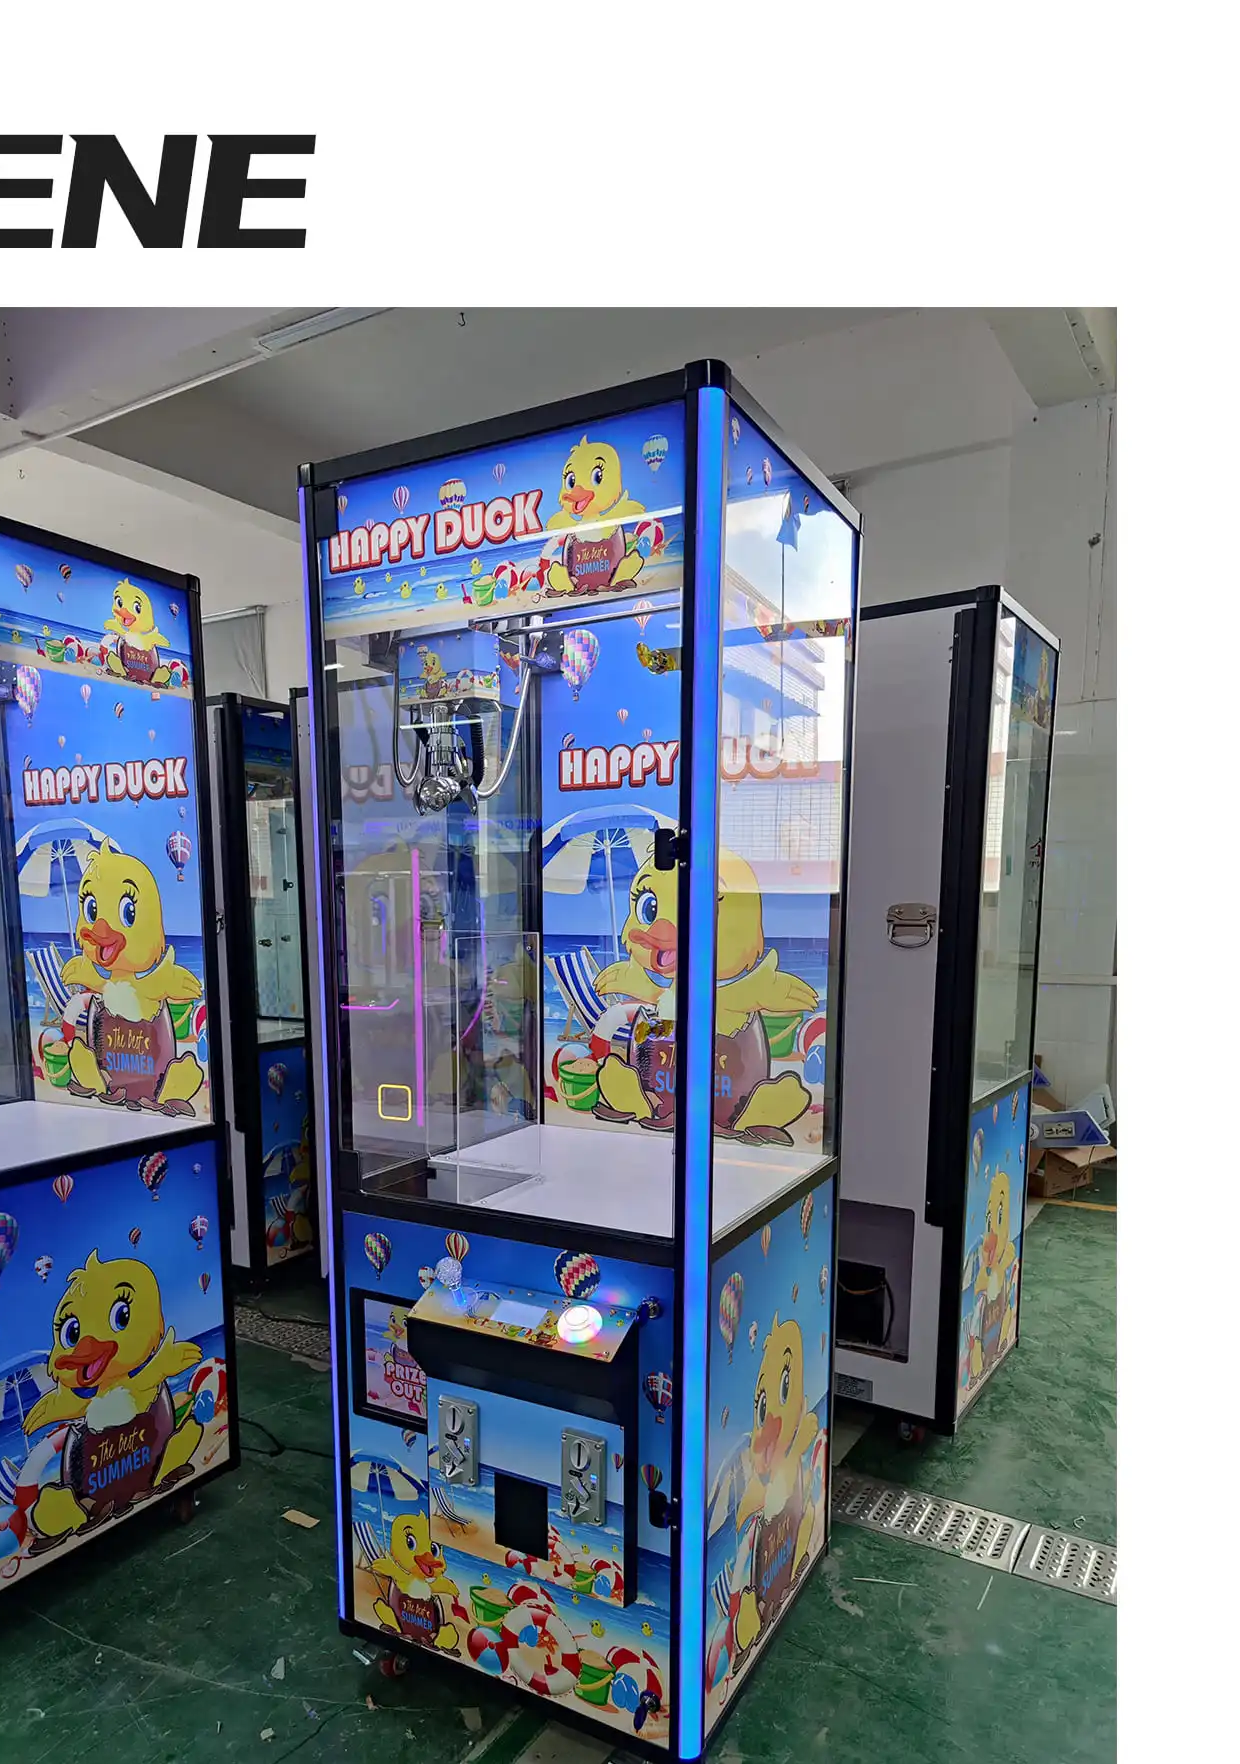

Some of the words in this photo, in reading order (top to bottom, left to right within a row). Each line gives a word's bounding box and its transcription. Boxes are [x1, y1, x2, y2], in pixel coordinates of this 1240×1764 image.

[328, 513, 431, 574] HAPPY
[433, 488, 543, 555] DUCK
[575, 559, 610, 577] SUMMER
[559, 740, 680, 791] HAPPY
[23, 764, 101, 807] HAPPY
[104, 756, 189, 802] DUCK
[113, 1027, 126, 1049] The
[105, 1051, 155, 1076] SUMMER
[391, 1380, 424, 1403] OUT
[98, 1438, 116, 1467] The
[88, 1445, 150, 1495] SUMMER
